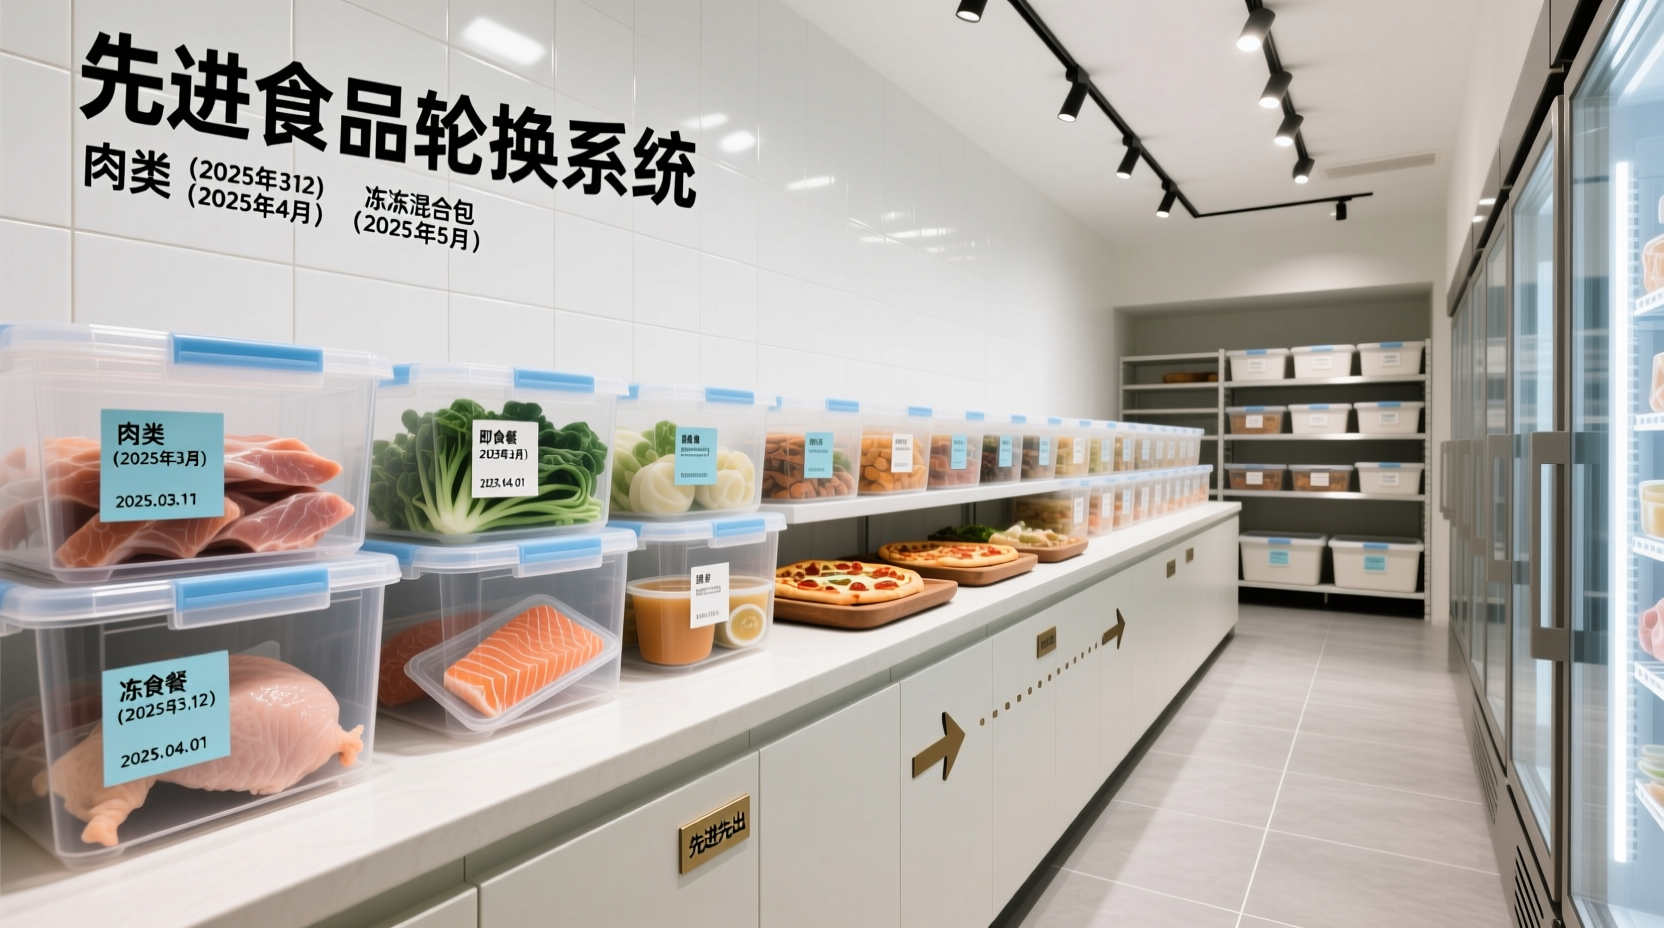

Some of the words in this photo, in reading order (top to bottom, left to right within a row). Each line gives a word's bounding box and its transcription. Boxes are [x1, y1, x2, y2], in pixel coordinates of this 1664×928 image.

[79, 31, 697, 209] 先进食品轮换系统
[84, 142, 171, 200] 肉类
[187, 183, 323, 228] (2025年4月)
[353, 210, 480, 254] (2025年5月)
[118, 421, 165, 446] 肉类
[113, 450, 207, 468] (2025年3月)
[115, 492, 197, 509] 2025.03.11
[120, 735, 207, 769] 2025.04.01
